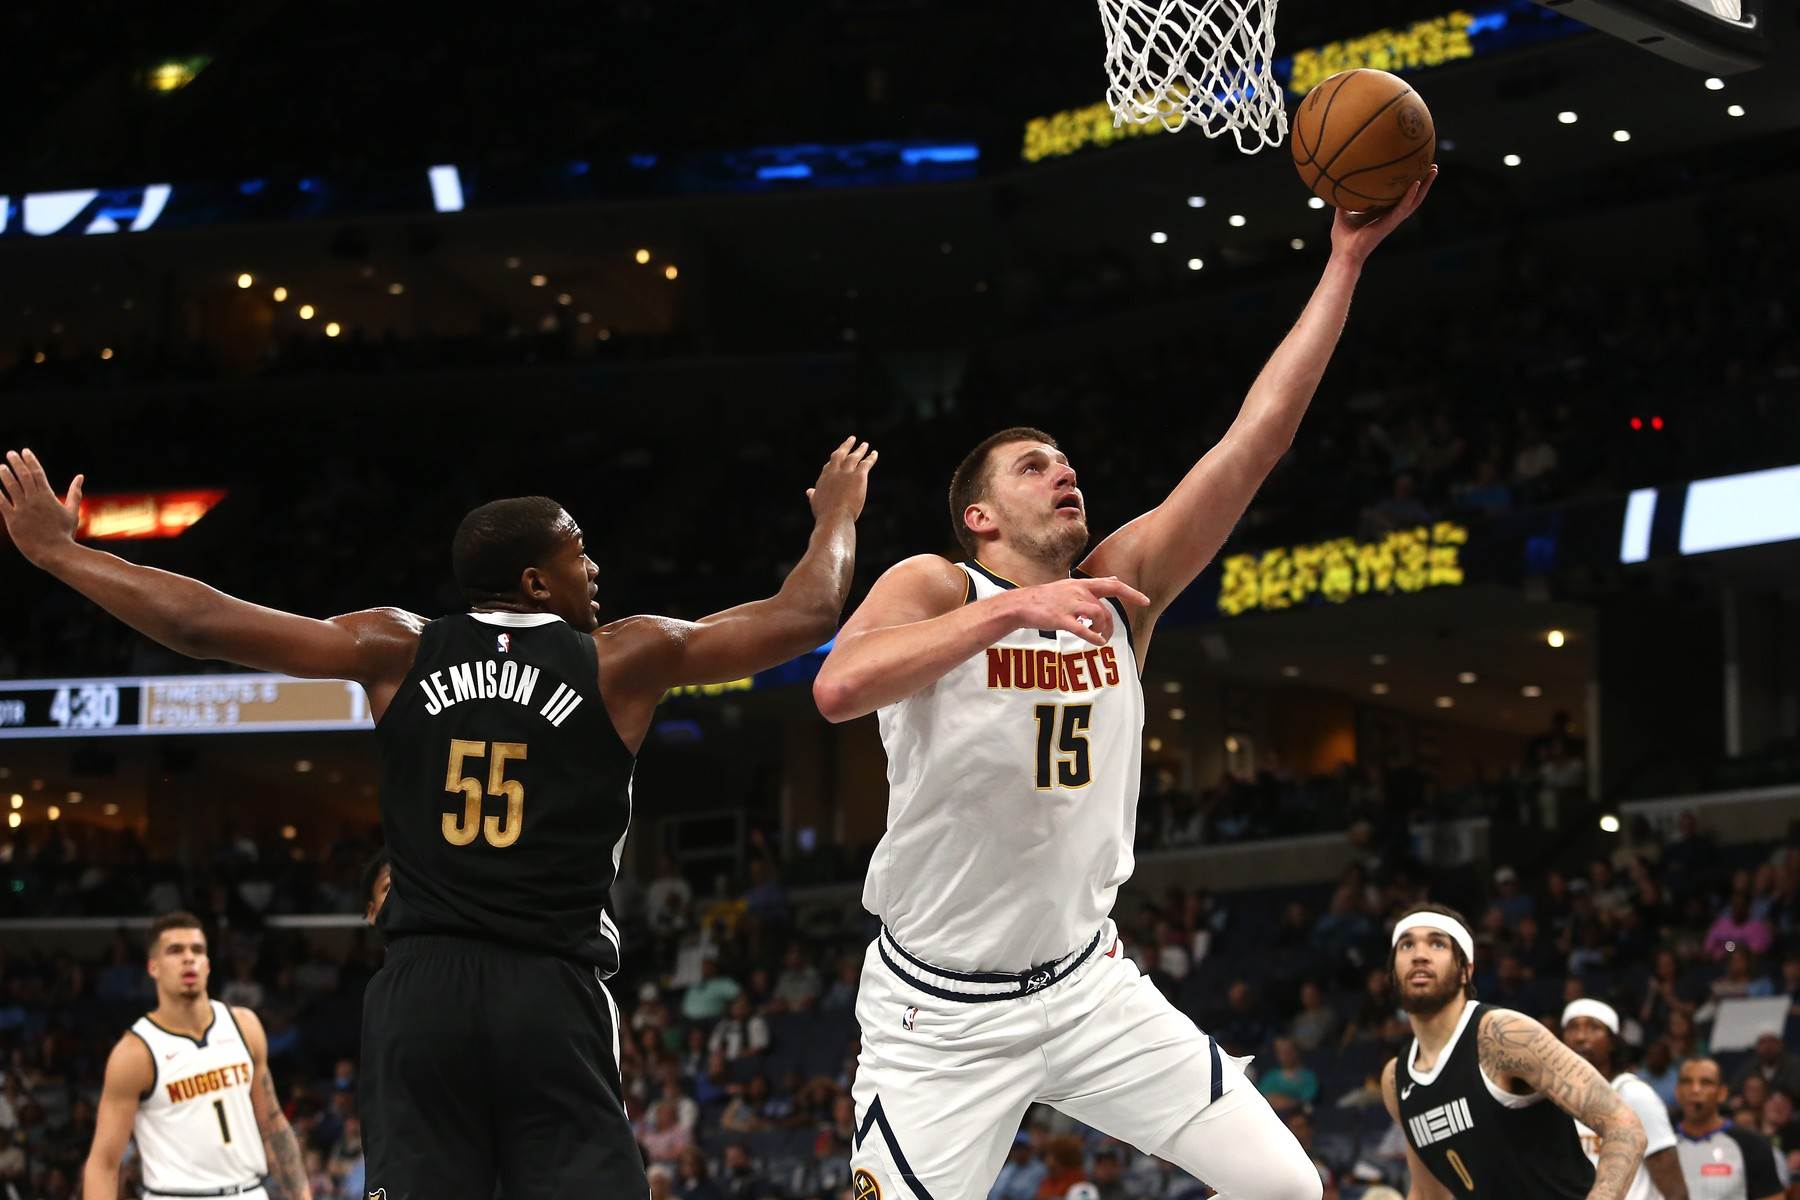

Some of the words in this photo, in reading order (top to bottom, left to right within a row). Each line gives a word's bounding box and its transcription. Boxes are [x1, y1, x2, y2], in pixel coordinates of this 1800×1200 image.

[49, 683, 119, 728] 4:30
[419, 660, 540, 716] JEMISON
[539, 682, 584, 727] III
[1034, 704, 1093, 790] 15
[441, 738, 528, 848] 55
[166, 1062, 249, 1104] NUGGETS
[213, 1099, 231, 1144] 1
[1446, 1149, 1474, 1191] 0
